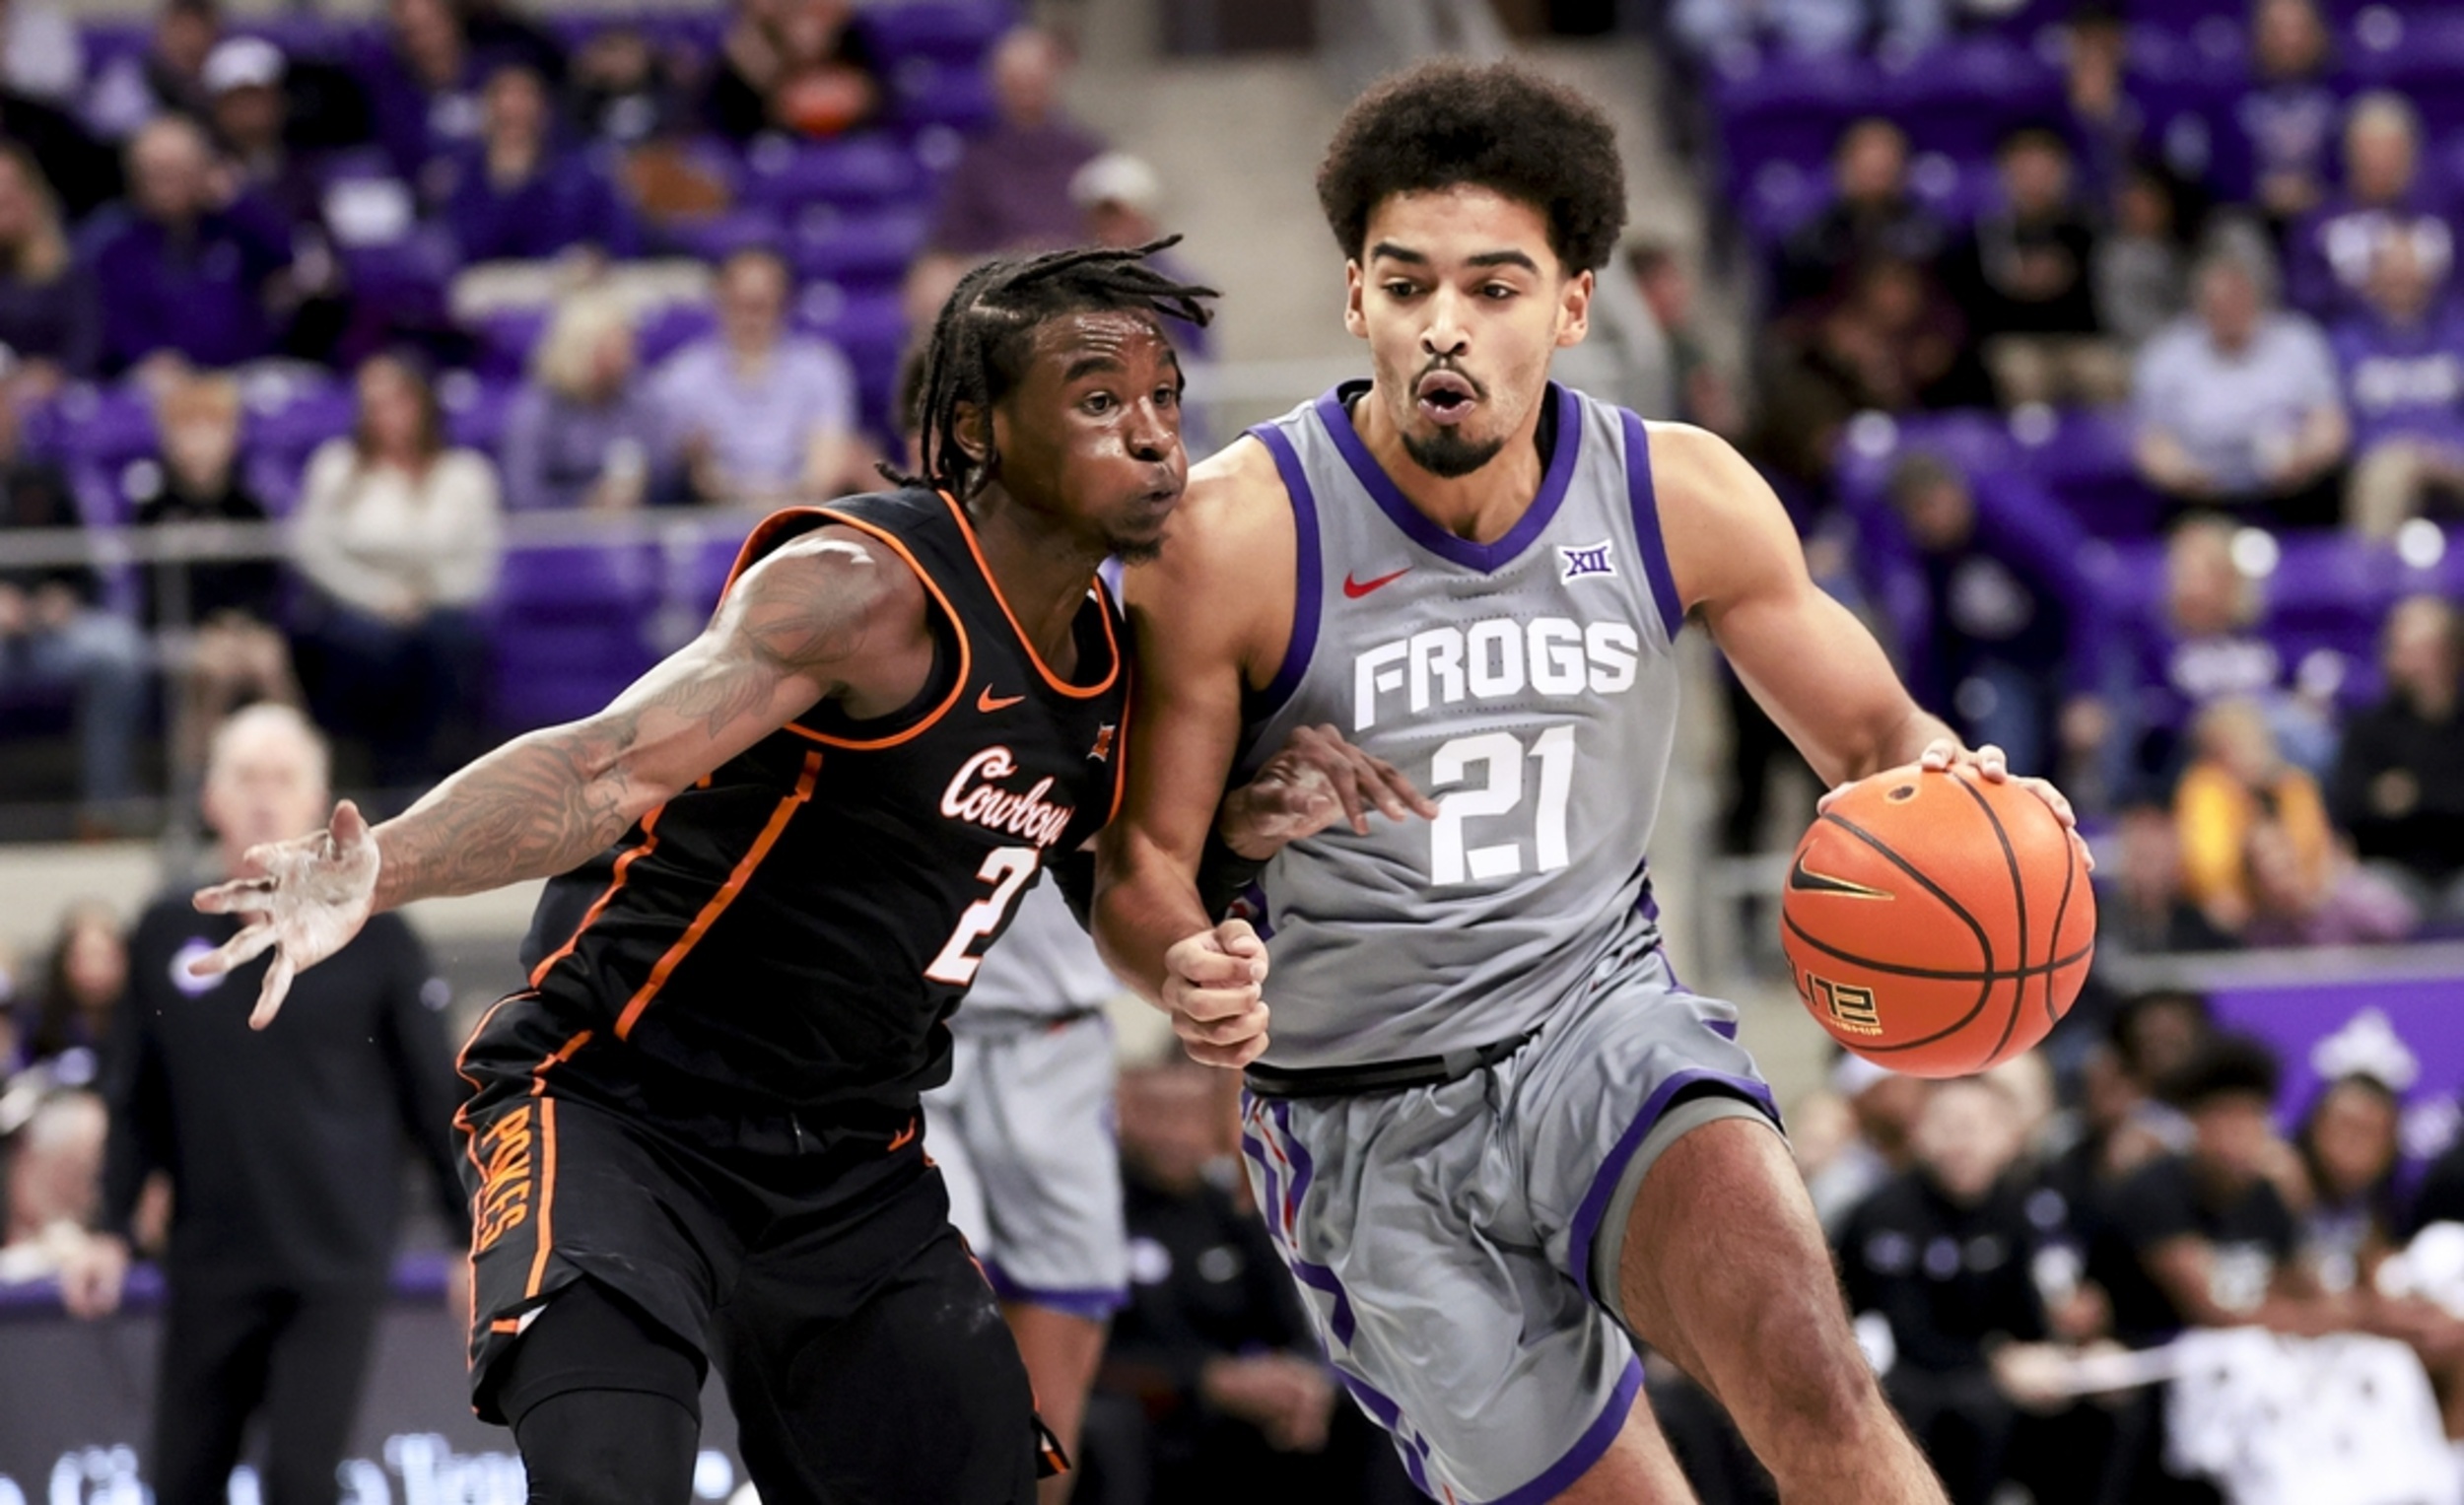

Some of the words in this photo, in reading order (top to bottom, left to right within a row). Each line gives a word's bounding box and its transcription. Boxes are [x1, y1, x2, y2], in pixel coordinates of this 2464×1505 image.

[1563, 546, 1612, 577] XII
[1354, 617, 1638, 732] FROGS
[1431, 724, 1575, 886] 21
[923, 846, 1041, 987] 2
[1785, 952, 1880, 1026] LITE
[478, 1103, 533, 1252] POKES
